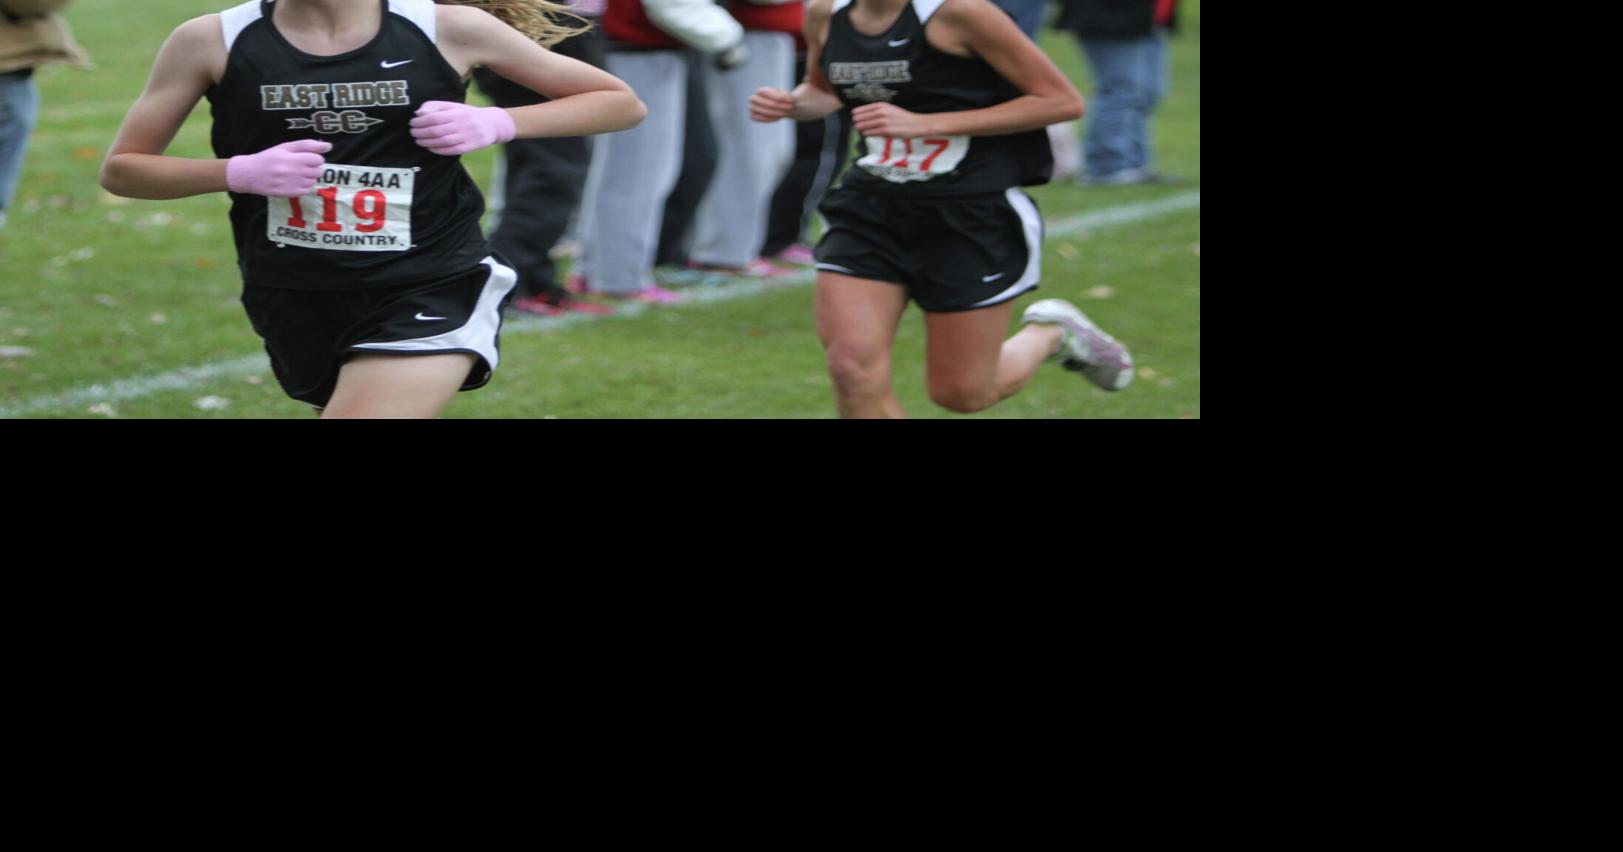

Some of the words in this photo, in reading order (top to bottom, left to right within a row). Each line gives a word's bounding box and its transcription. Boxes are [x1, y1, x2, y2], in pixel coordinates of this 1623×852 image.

[260, 84, 329, 110] EAST
[332, 80, 410, 107] RIDGE
[311, 110, 368, 134] CC
[317, 168, 350, 185] ON
[358, 172, 400, 188] 4AA
[287, 187, 386, 232] 119
[276, 226, 317, 242] CROSS
[322, 232, 397, 246] COUNTRY
